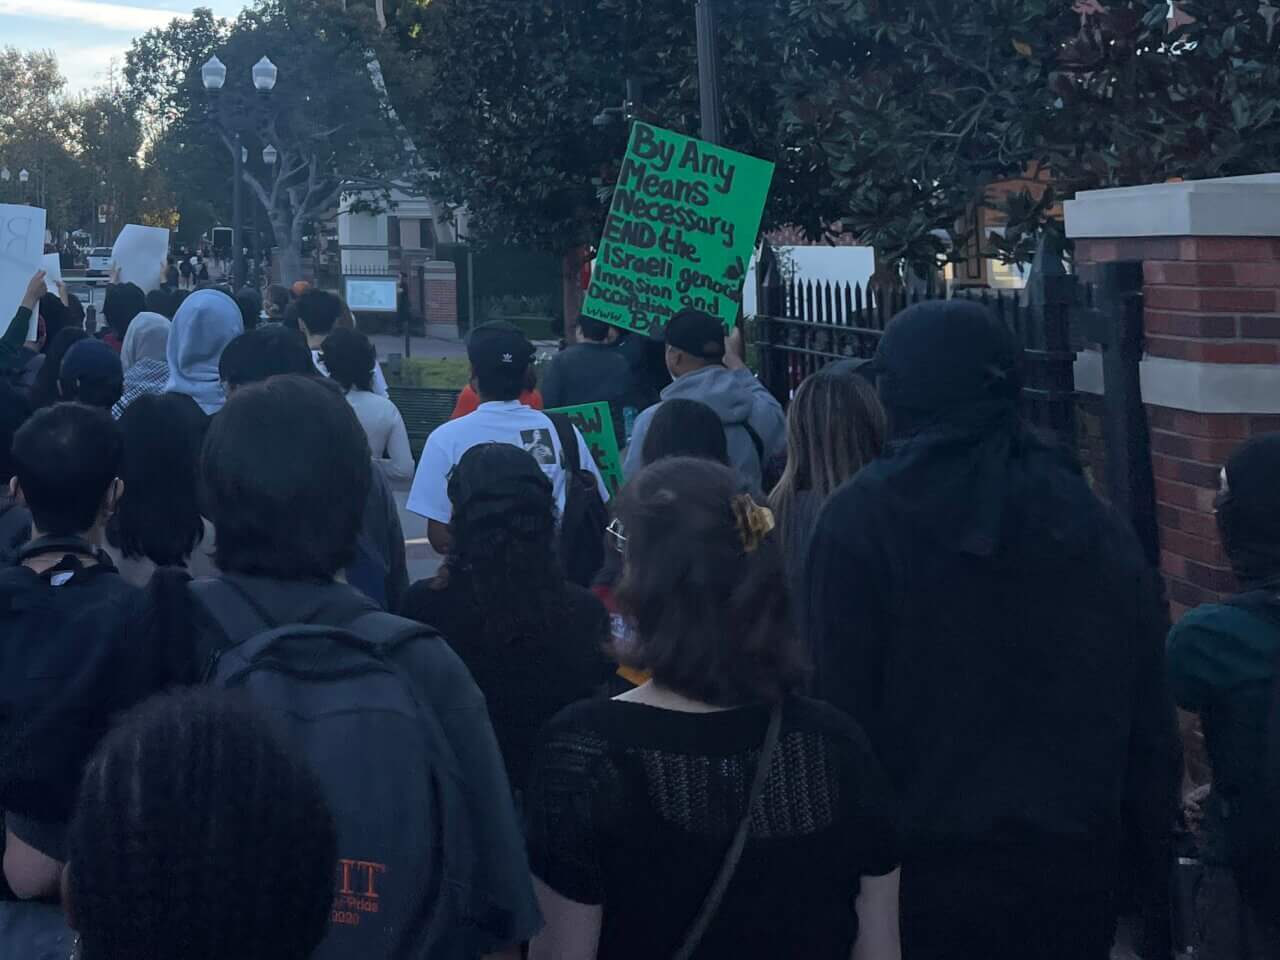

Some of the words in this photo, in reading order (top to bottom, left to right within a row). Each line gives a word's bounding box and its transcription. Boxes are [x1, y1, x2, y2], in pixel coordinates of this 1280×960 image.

[618, 158, 710, 207] Means
[631, 123, 675, 172] By
[678, 140, 736, 194] Any
[603, 216, 657, 249] END
[658, 228, 701, 264] the
[611, 190, 735, 248] Necessary
